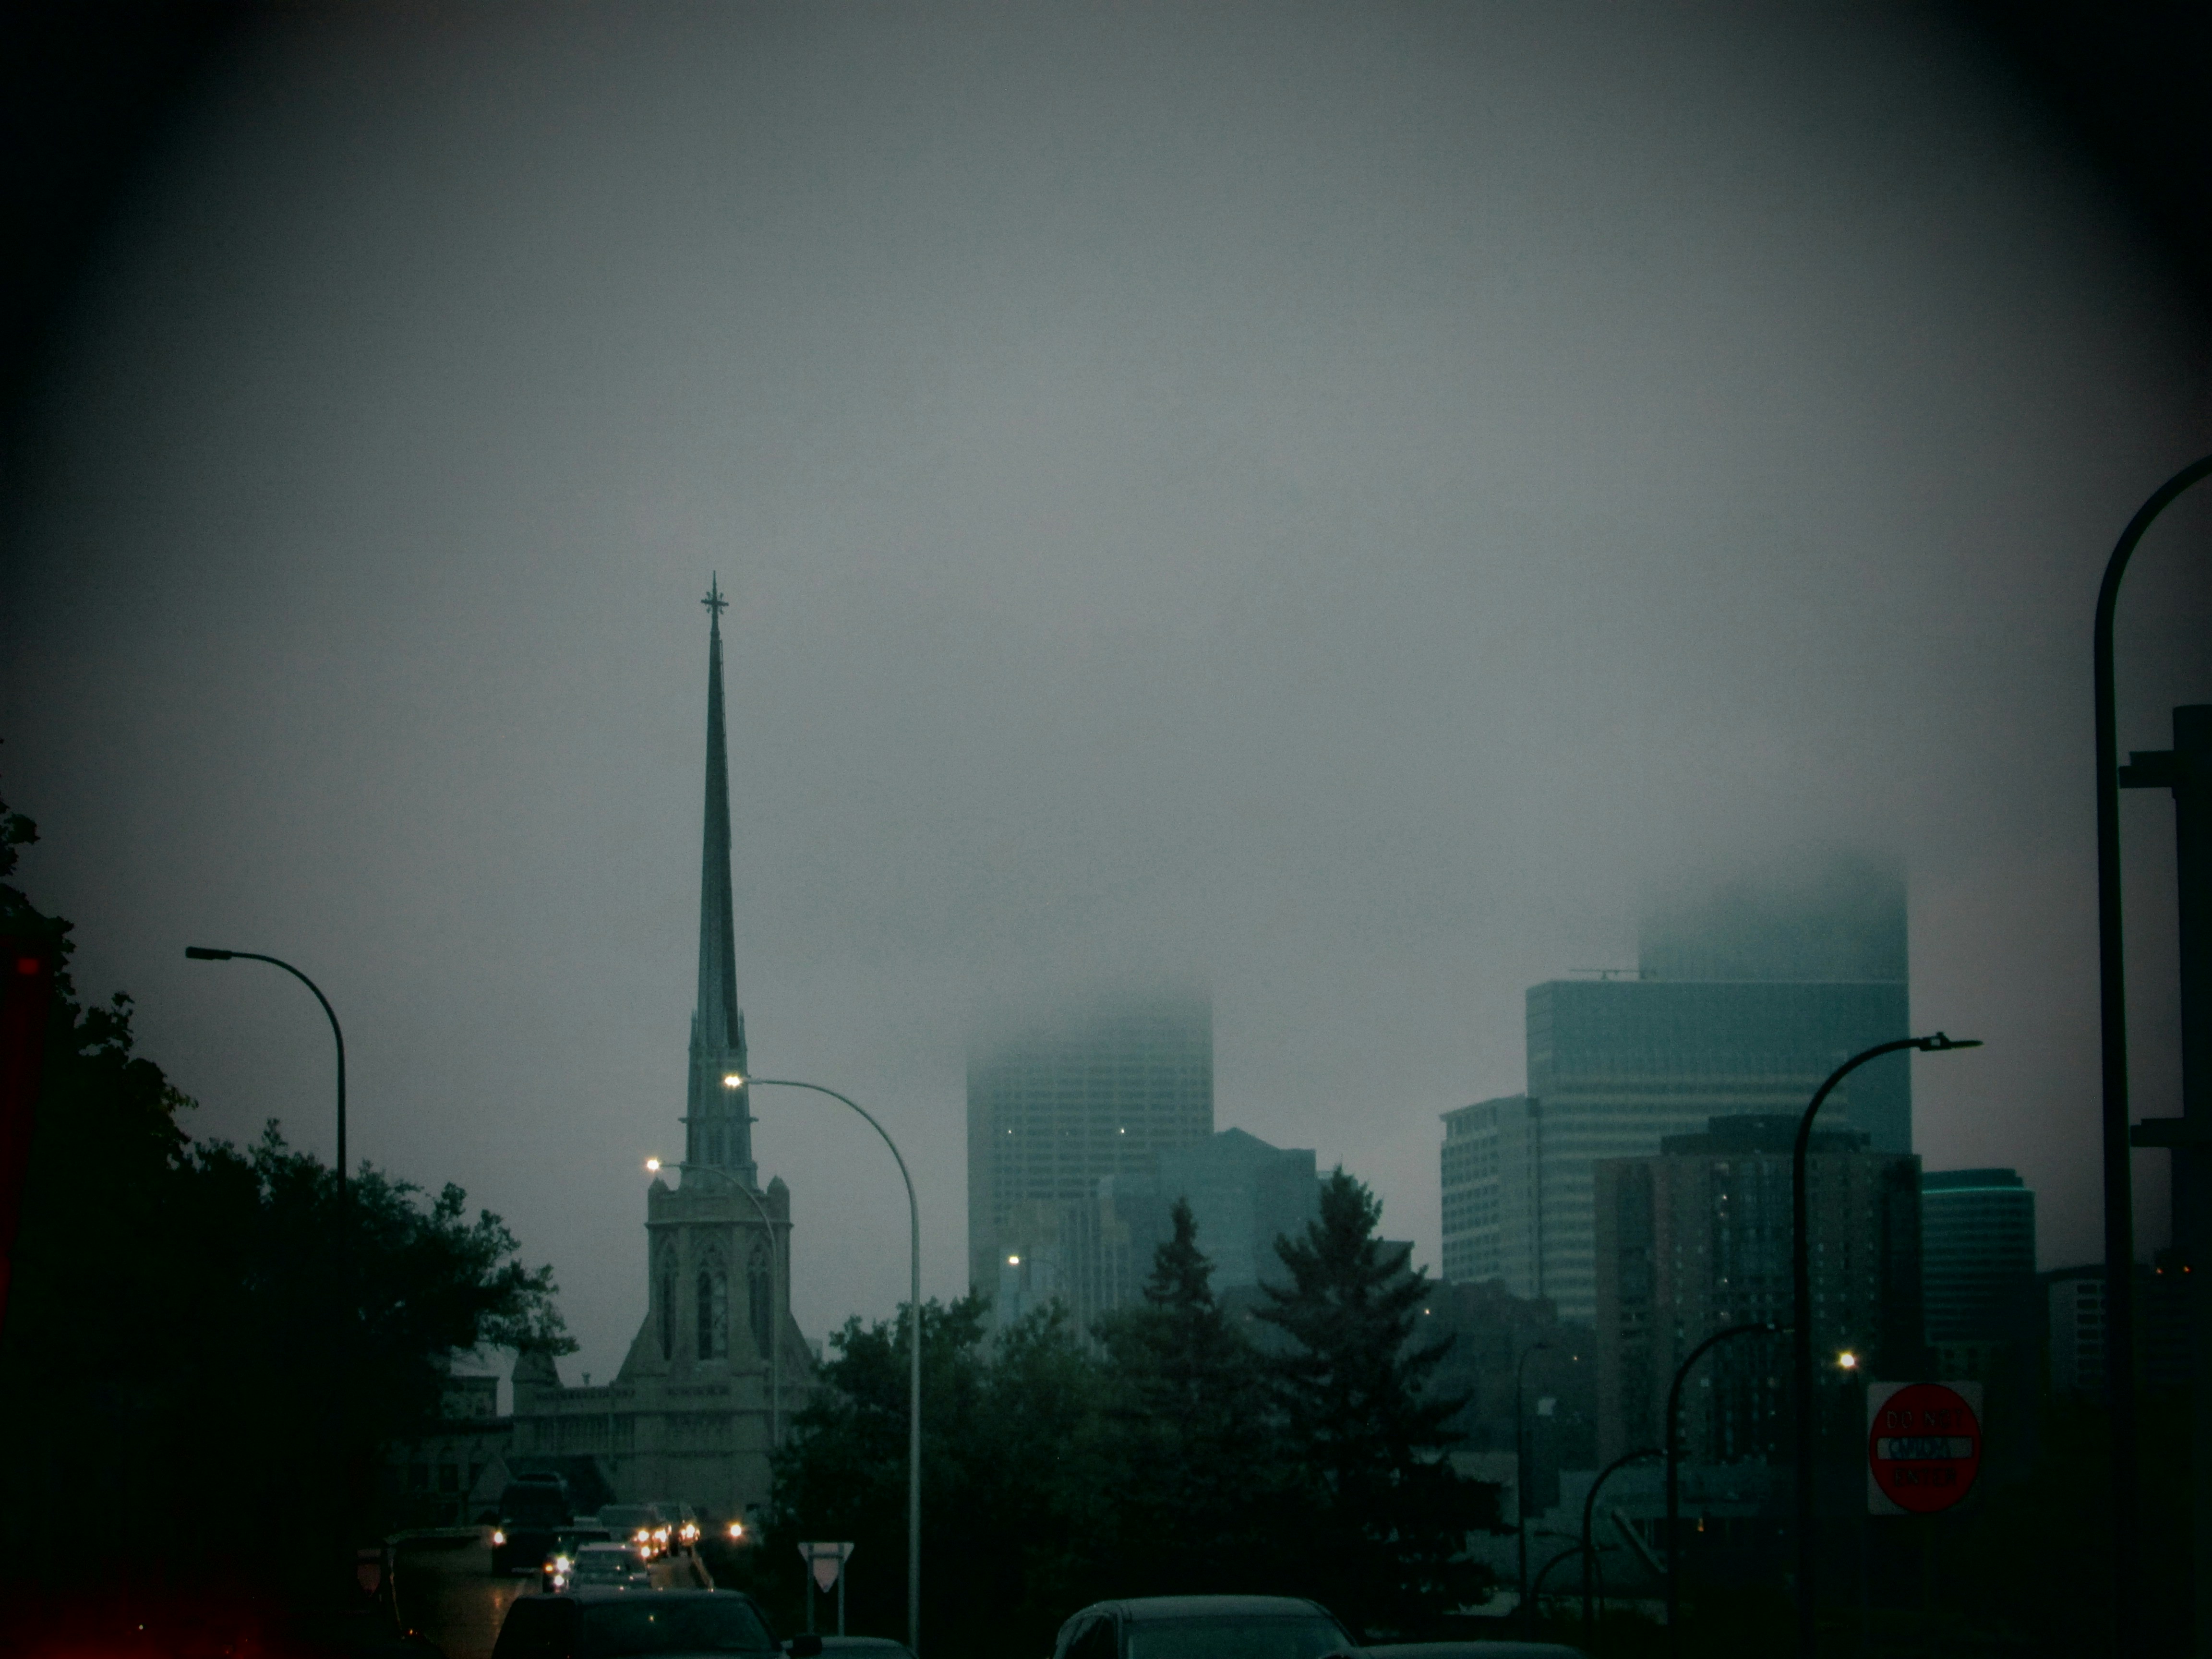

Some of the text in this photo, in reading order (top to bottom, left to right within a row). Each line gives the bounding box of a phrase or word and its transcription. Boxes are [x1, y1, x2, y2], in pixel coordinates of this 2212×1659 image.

[1887, 1409, 1962, 1429] DO NOT
[1894, 1467, 1957, 1487] ENTER
